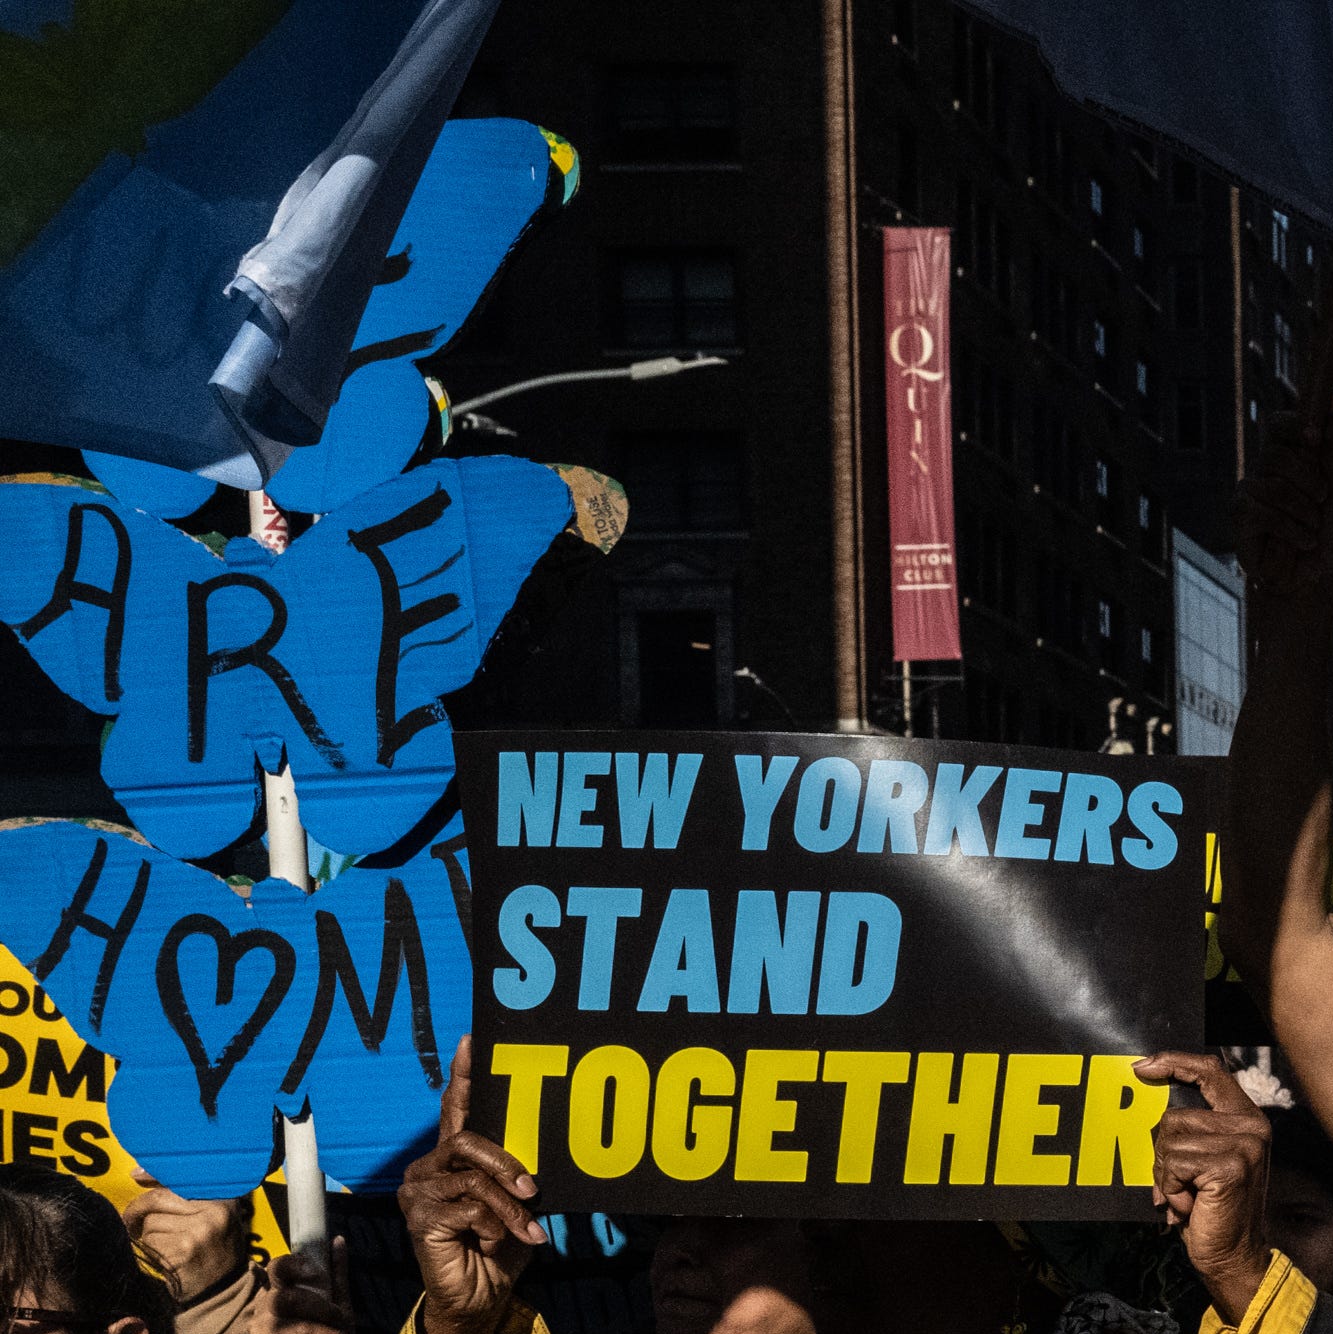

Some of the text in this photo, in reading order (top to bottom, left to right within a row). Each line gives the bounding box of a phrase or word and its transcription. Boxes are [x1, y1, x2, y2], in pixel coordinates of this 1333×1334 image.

[498, 751, 1184, 871] NEW YORKERS
[492, 884, 902, 1016] STAND
[490, 1043, 1170, 1187] TOGETHER
